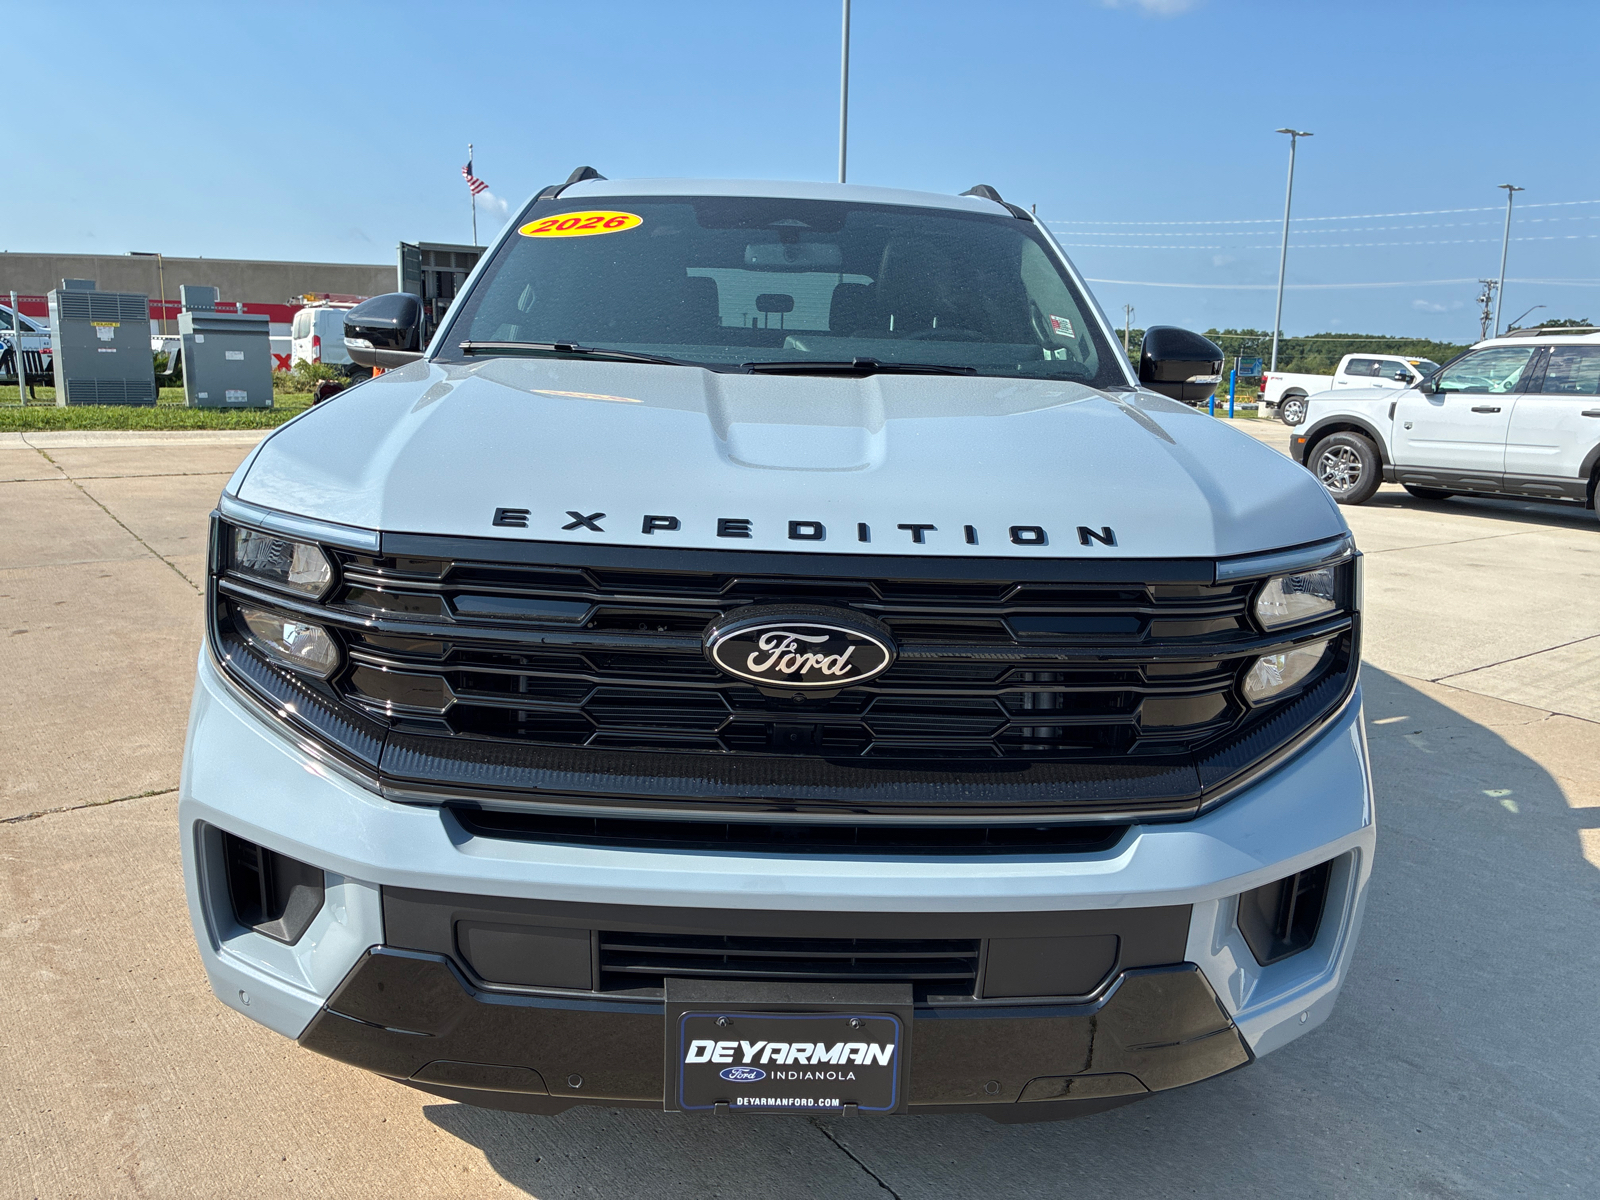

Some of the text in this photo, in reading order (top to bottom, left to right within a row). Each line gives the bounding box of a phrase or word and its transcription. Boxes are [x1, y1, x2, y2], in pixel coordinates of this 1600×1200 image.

[530, 216, 630, 234] 2026
[492, 507, 1118, 547] EXPEDITION
[746, 630, 856, 676] Ford
[684, 1039, 895, 1066] DEYARMAN
[728, 1067, 856, 1081] Ford INDIANOLA
[736, 1097, 840, 1107] DEYARMANFORD.COM
